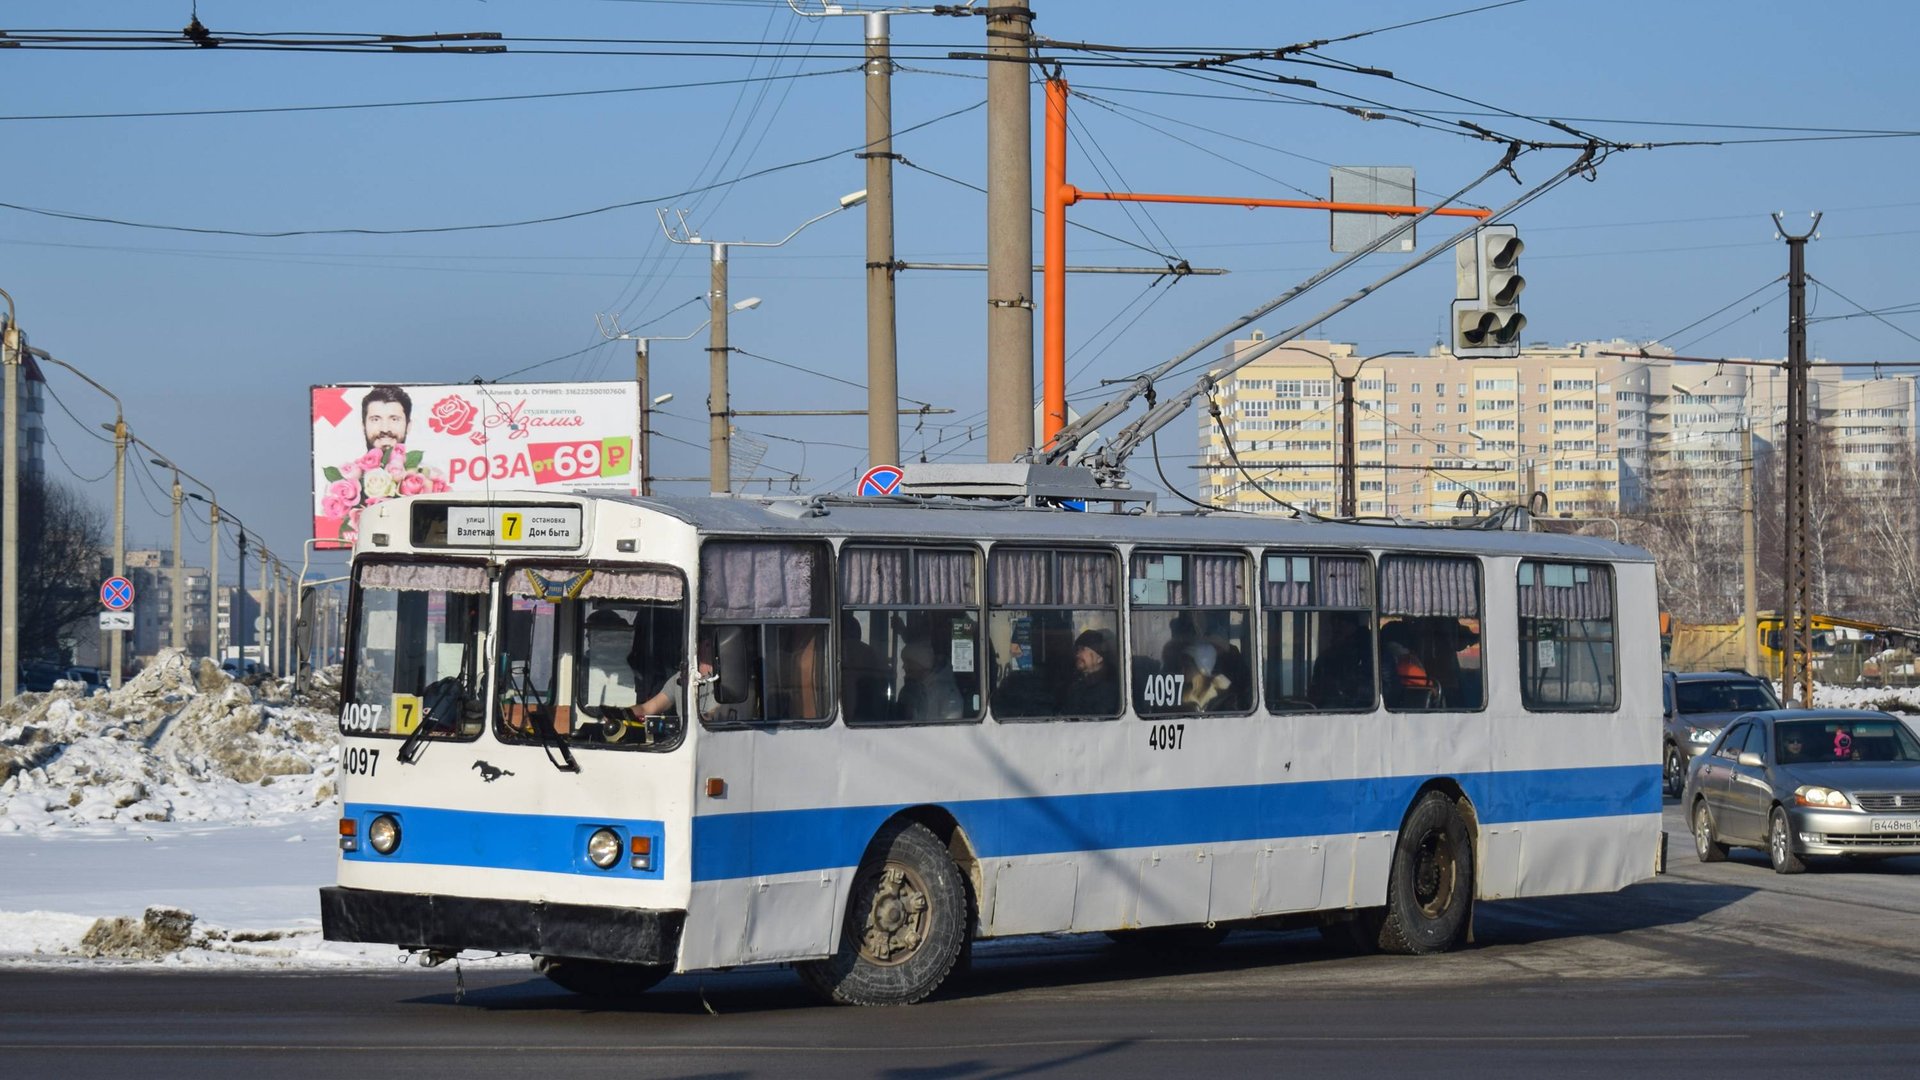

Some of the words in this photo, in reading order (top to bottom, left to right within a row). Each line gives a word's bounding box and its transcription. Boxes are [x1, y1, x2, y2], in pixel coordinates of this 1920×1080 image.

[483, 399, 584, 439] Азалия
[449, 452, 530, 484] РОЗА
[554, 443, 600, 477] 69
[457, 527, 495, 536] Взлетная
[507, 517, 517, 536] 7
[529, 527, 547, 538] Дом
[548, 527, 570, 537] быта
[1144, 674, 1184, 706] 4097
[341, 702, 382, 731] 4097
[402, 704, 413, 727] 7
[1149, 724, 1184, 750] 4097
[343, 747, 379, 776] 4097
